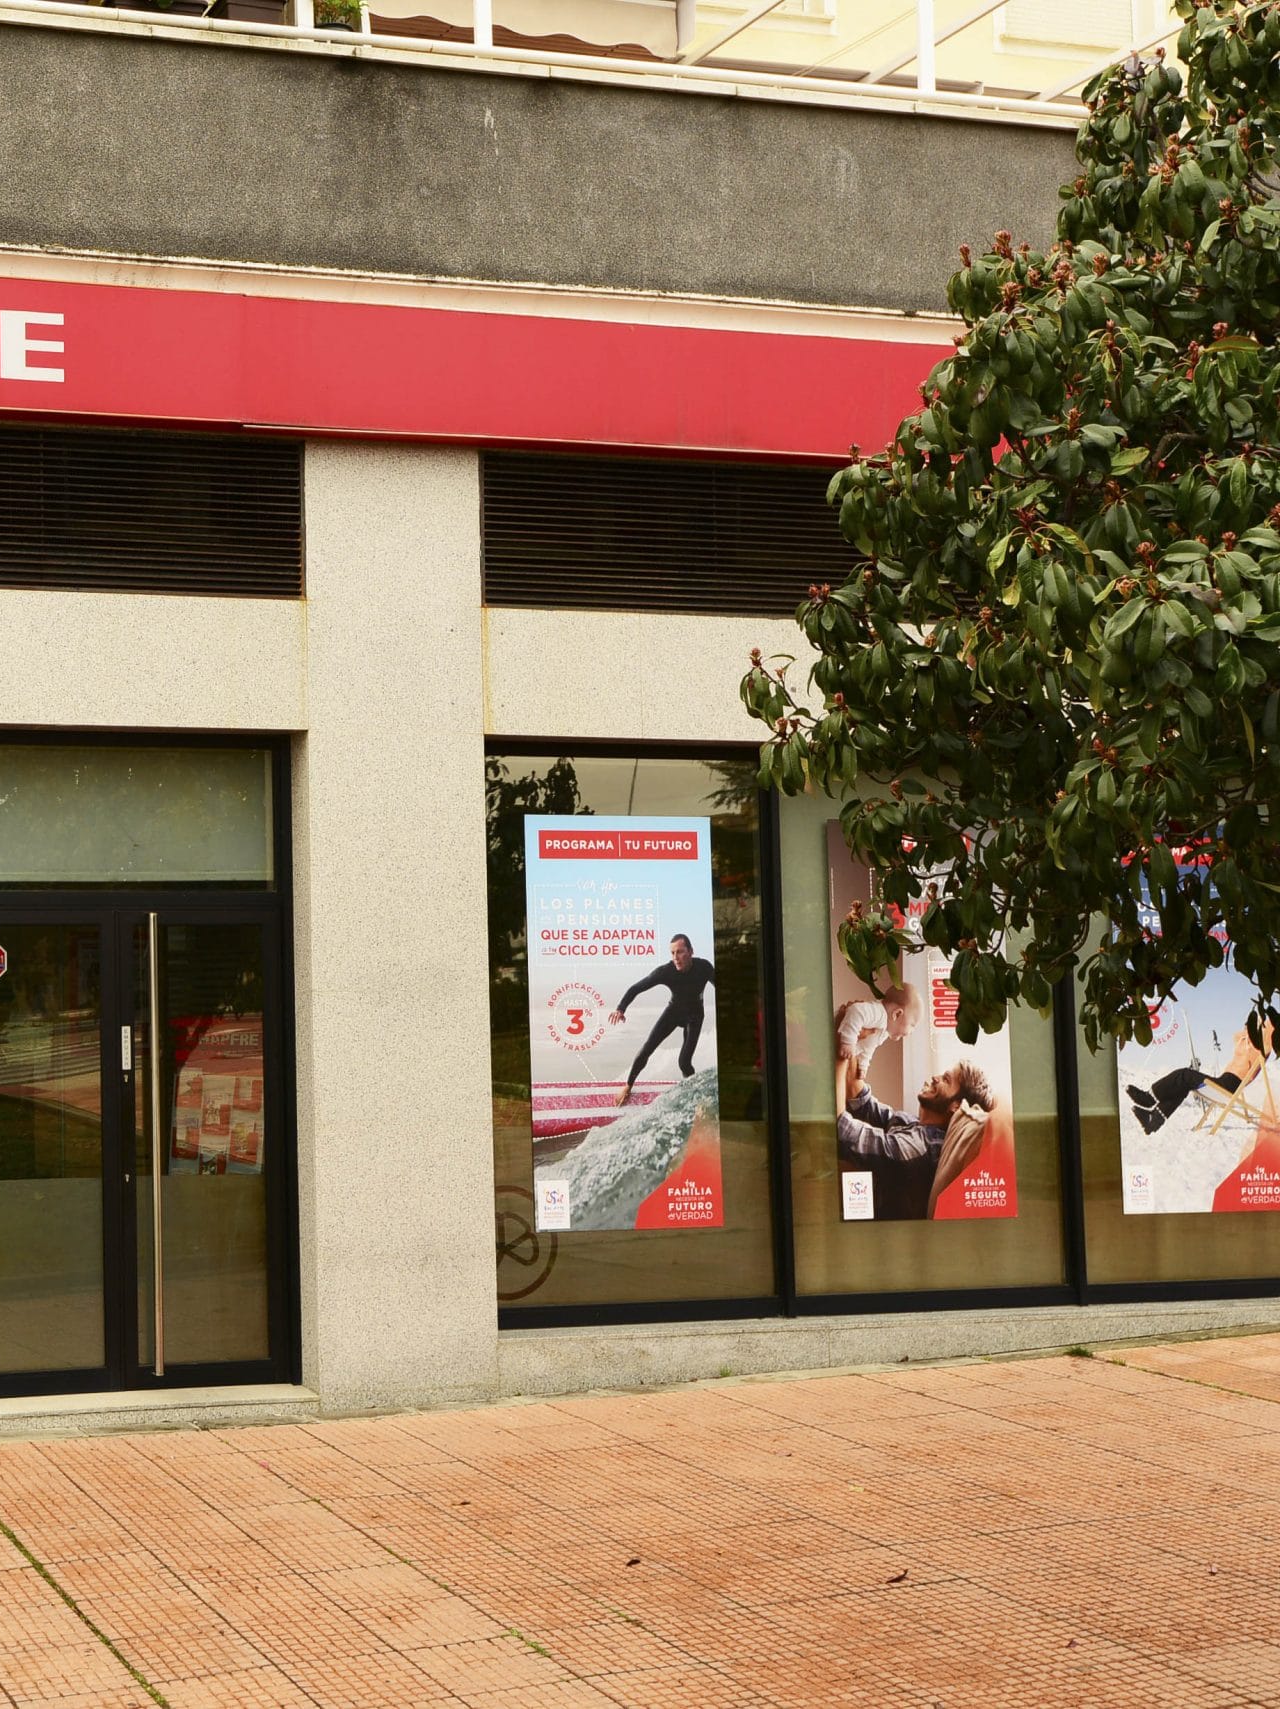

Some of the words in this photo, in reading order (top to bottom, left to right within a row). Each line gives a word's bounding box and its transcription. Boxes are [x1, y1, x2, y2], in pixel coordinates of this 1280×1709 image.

[545, 839, 614, 850] PROGRAMA
[624, 840, 640, 850] TU
[644, 840, 692, 851] FUTURO
[540, 897, 574, 910] LOS
[584, 897, 654, 910] PLANES
[556, 913, 655, 926] PENSIONES
[541, 929, 569, 941] QUE
[572, 929, 588, 940] SE
[592, 929, 655, 940] ADAPTAN
[558, 945, 598, 956] CICLO
[602, 945, 620, 956] DE
[624, 945, 655, 956] VIDA
[1152, 1023, 1179, 1046] ASLADO
[963, 1177, 1006, 1187] FAMILIA
[1240, 1172, 1280, 1182] FAMILIA
[667, 1186, 712, 1197] FAMILIA
[964, 1190, 1007, 1200] SEGURO
[1241, 1186, 1280, 1196] FUTURO
[972, 1198, 1007, 1208] VERDAD
[1248, 1195, 1280, 1204] VERDAD
[668, 1201, 713, 1211] FUTURO
[675, 1210, 713, 1221] VERDAD
